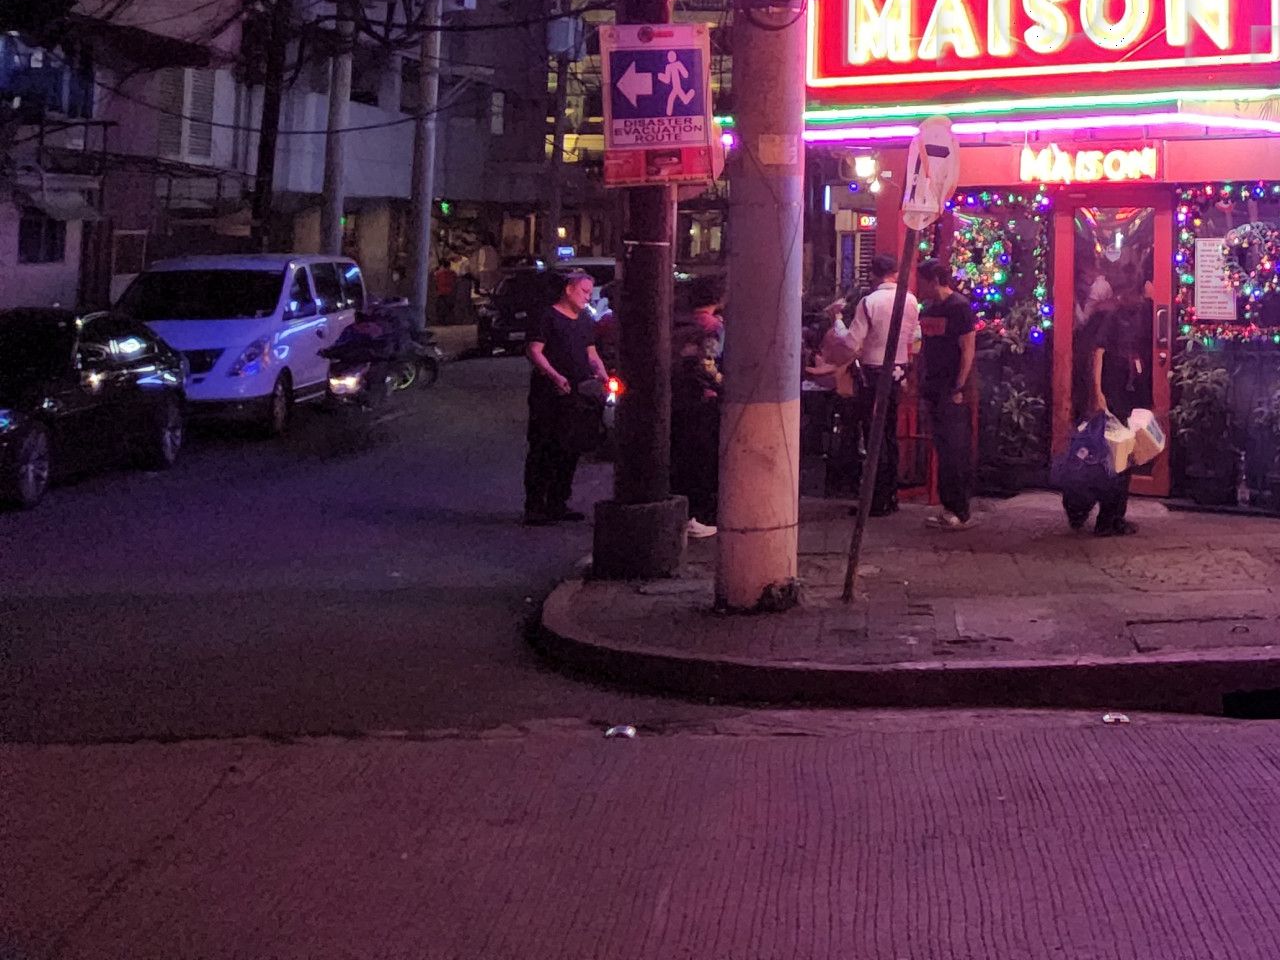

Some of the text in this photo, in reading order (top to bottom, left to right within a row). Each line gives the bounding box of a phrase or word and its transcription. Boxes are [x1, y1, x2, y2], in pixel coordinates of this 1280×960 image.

[624, 117, 693, 128] DISASTER
[614, 125, 702, 136] EVACUATION
[635, 133, 682, 142] ROUTE
